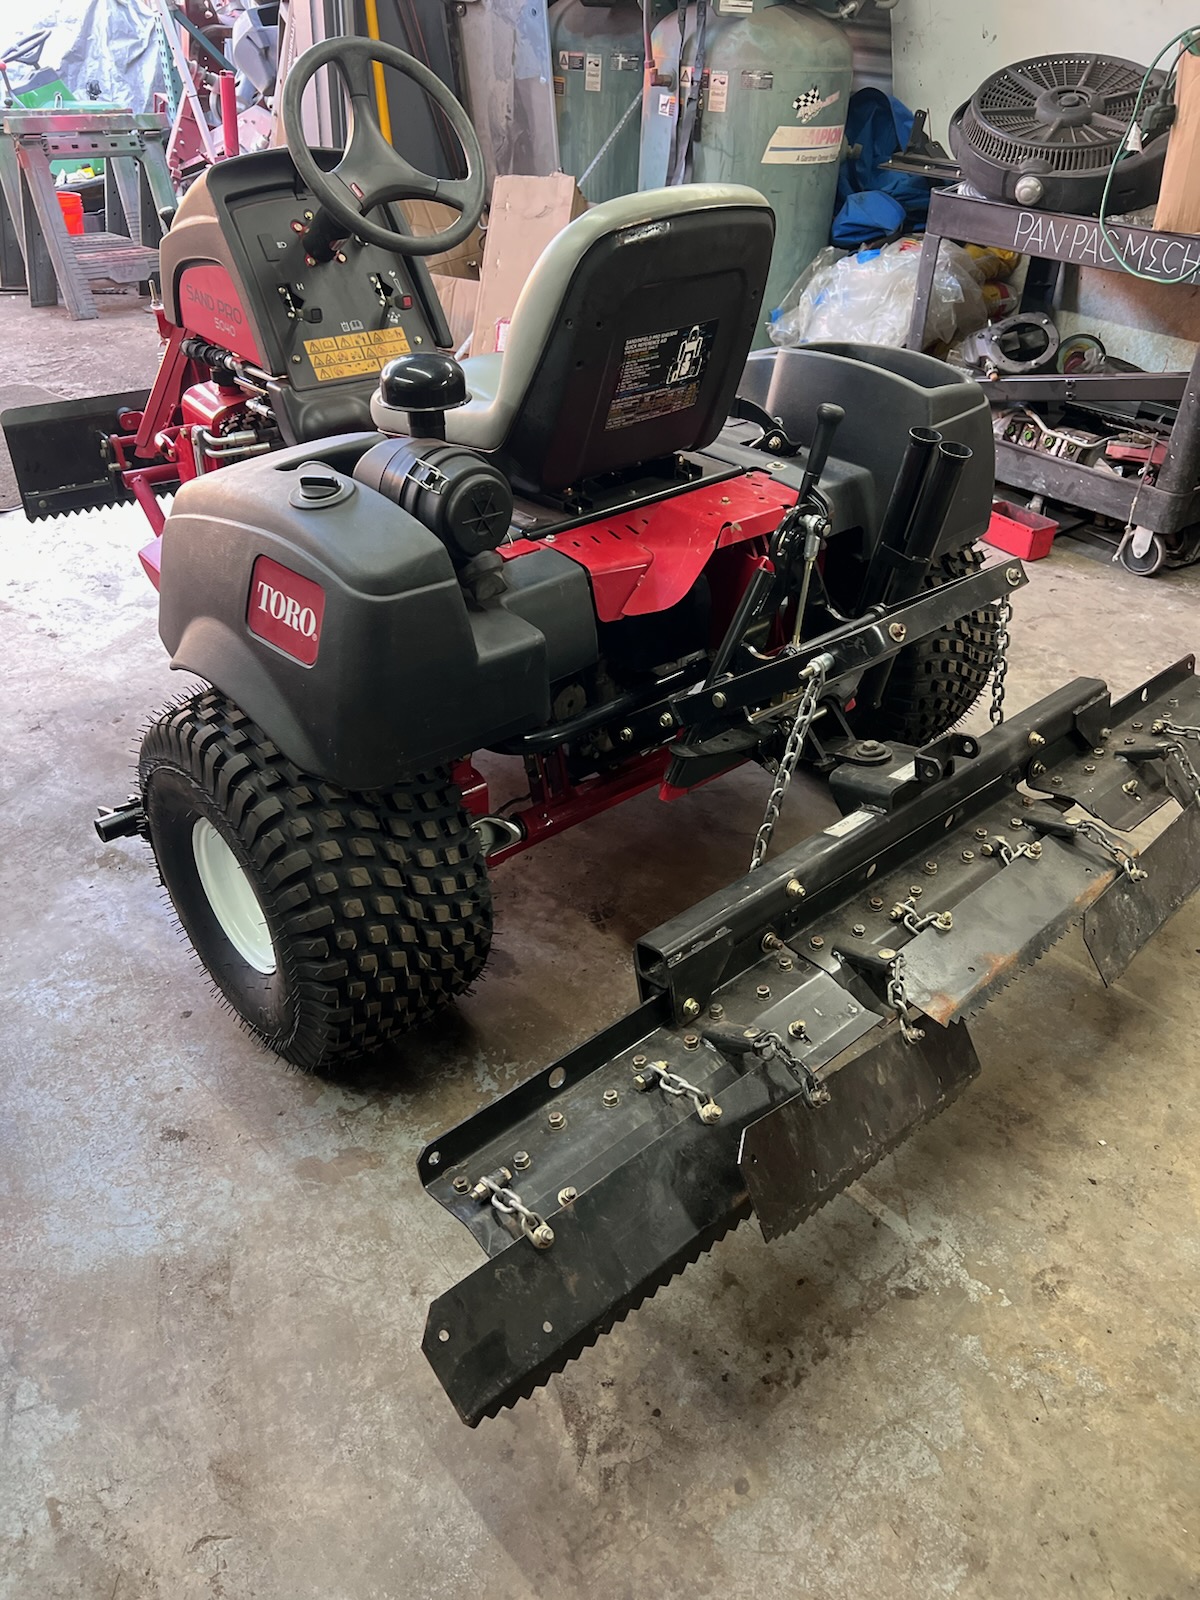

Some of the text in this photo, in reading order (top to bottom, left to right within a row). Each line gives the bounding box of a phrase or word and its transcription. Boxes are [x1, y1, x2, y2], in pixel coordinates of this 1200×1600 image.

[186, 284, 242, 325] SAND PRO
[214, 317, 236, 337] 5040
[258, 581, 317, 637] TORO
